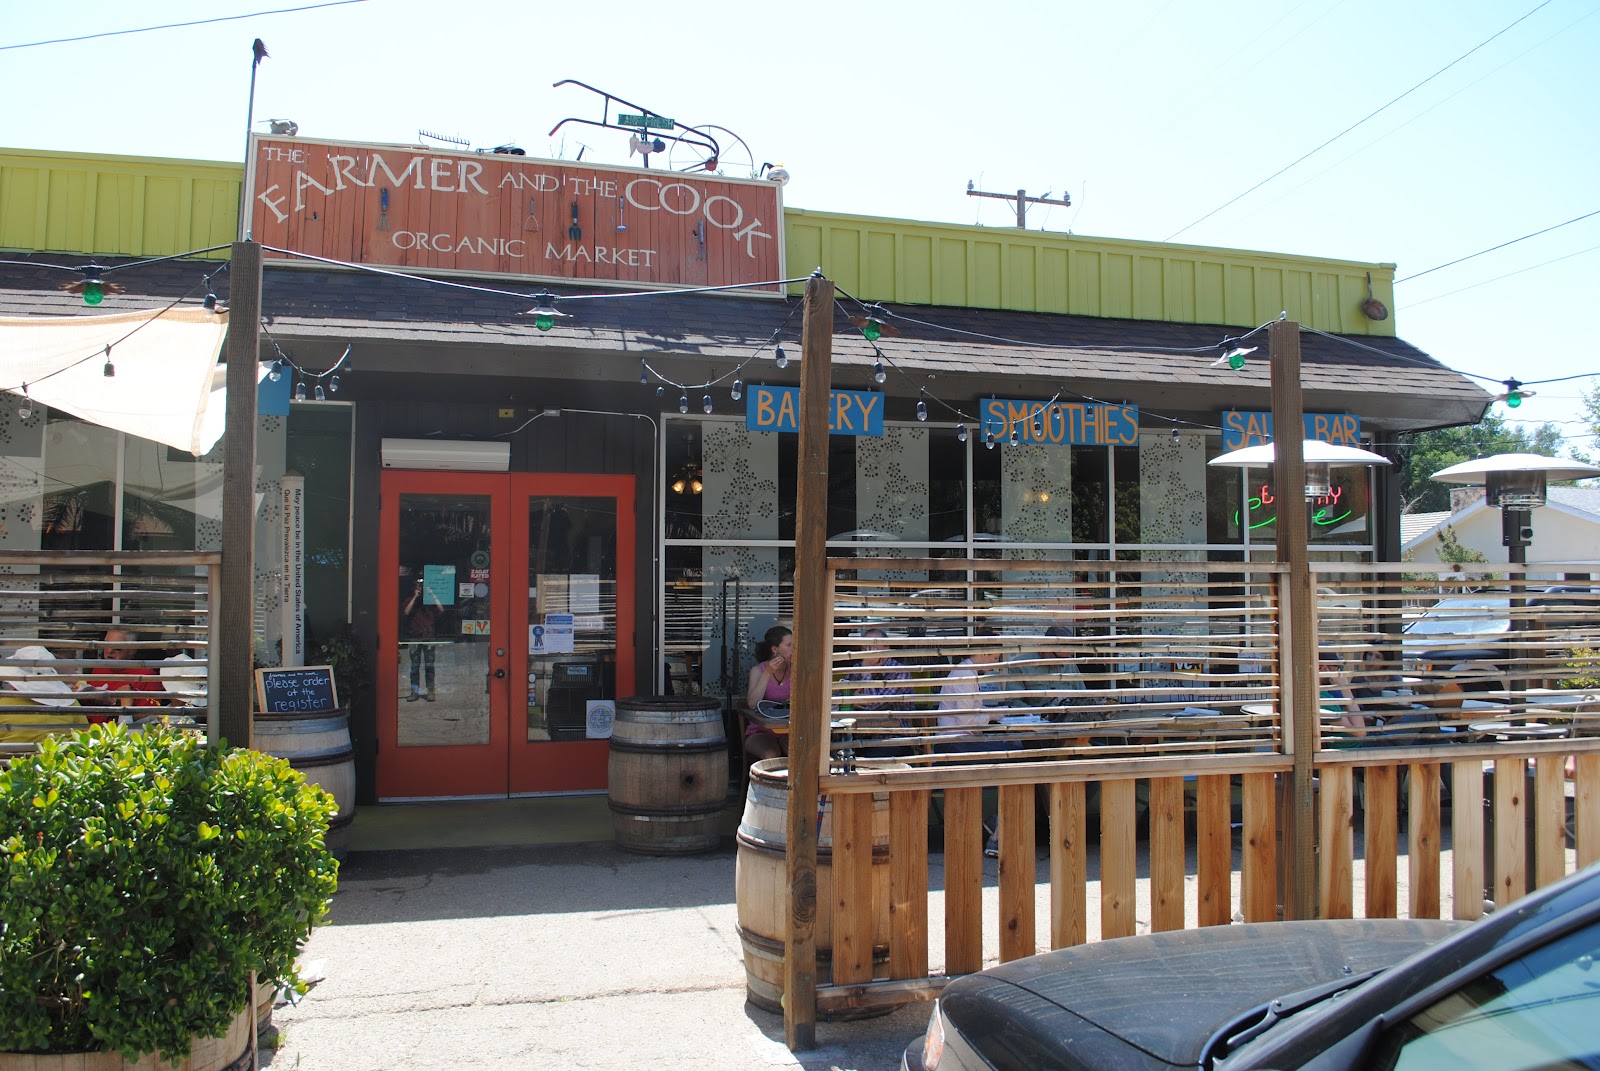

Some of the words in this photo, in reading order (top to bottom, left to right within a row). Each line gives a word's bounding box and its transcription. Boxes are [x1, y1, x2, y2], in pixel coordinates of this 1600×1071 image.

[262, 147, 305, 164] THE
[258, 153, 489, 224] FARMER
[497, 171, 560, 193] AND
[569, 176, 617, 199] THE
[625, 178, 772, 259] COOK
[392, 230, 526, 258] ORGANIC
[544, 242, 657, 267] MARKET
[756, 389, 879, 432] BARY
[984, 401, 1139, 445] SMOOTHIES
[1315, 415, 1361, 449] BAR
[294, 488, 302, 505] May
[295, 530, 302, 540] be
[295, 541, 302, 549] in
[284, 564, 289, 573] en
[295, 613, 302, 622] of
[265, 678, 300, 693] please
[302, 676, 330, 686] order
[287, 688, 298, 697] at
[301, 688, 316, 696] the
[274, 695, 327, 712] register
